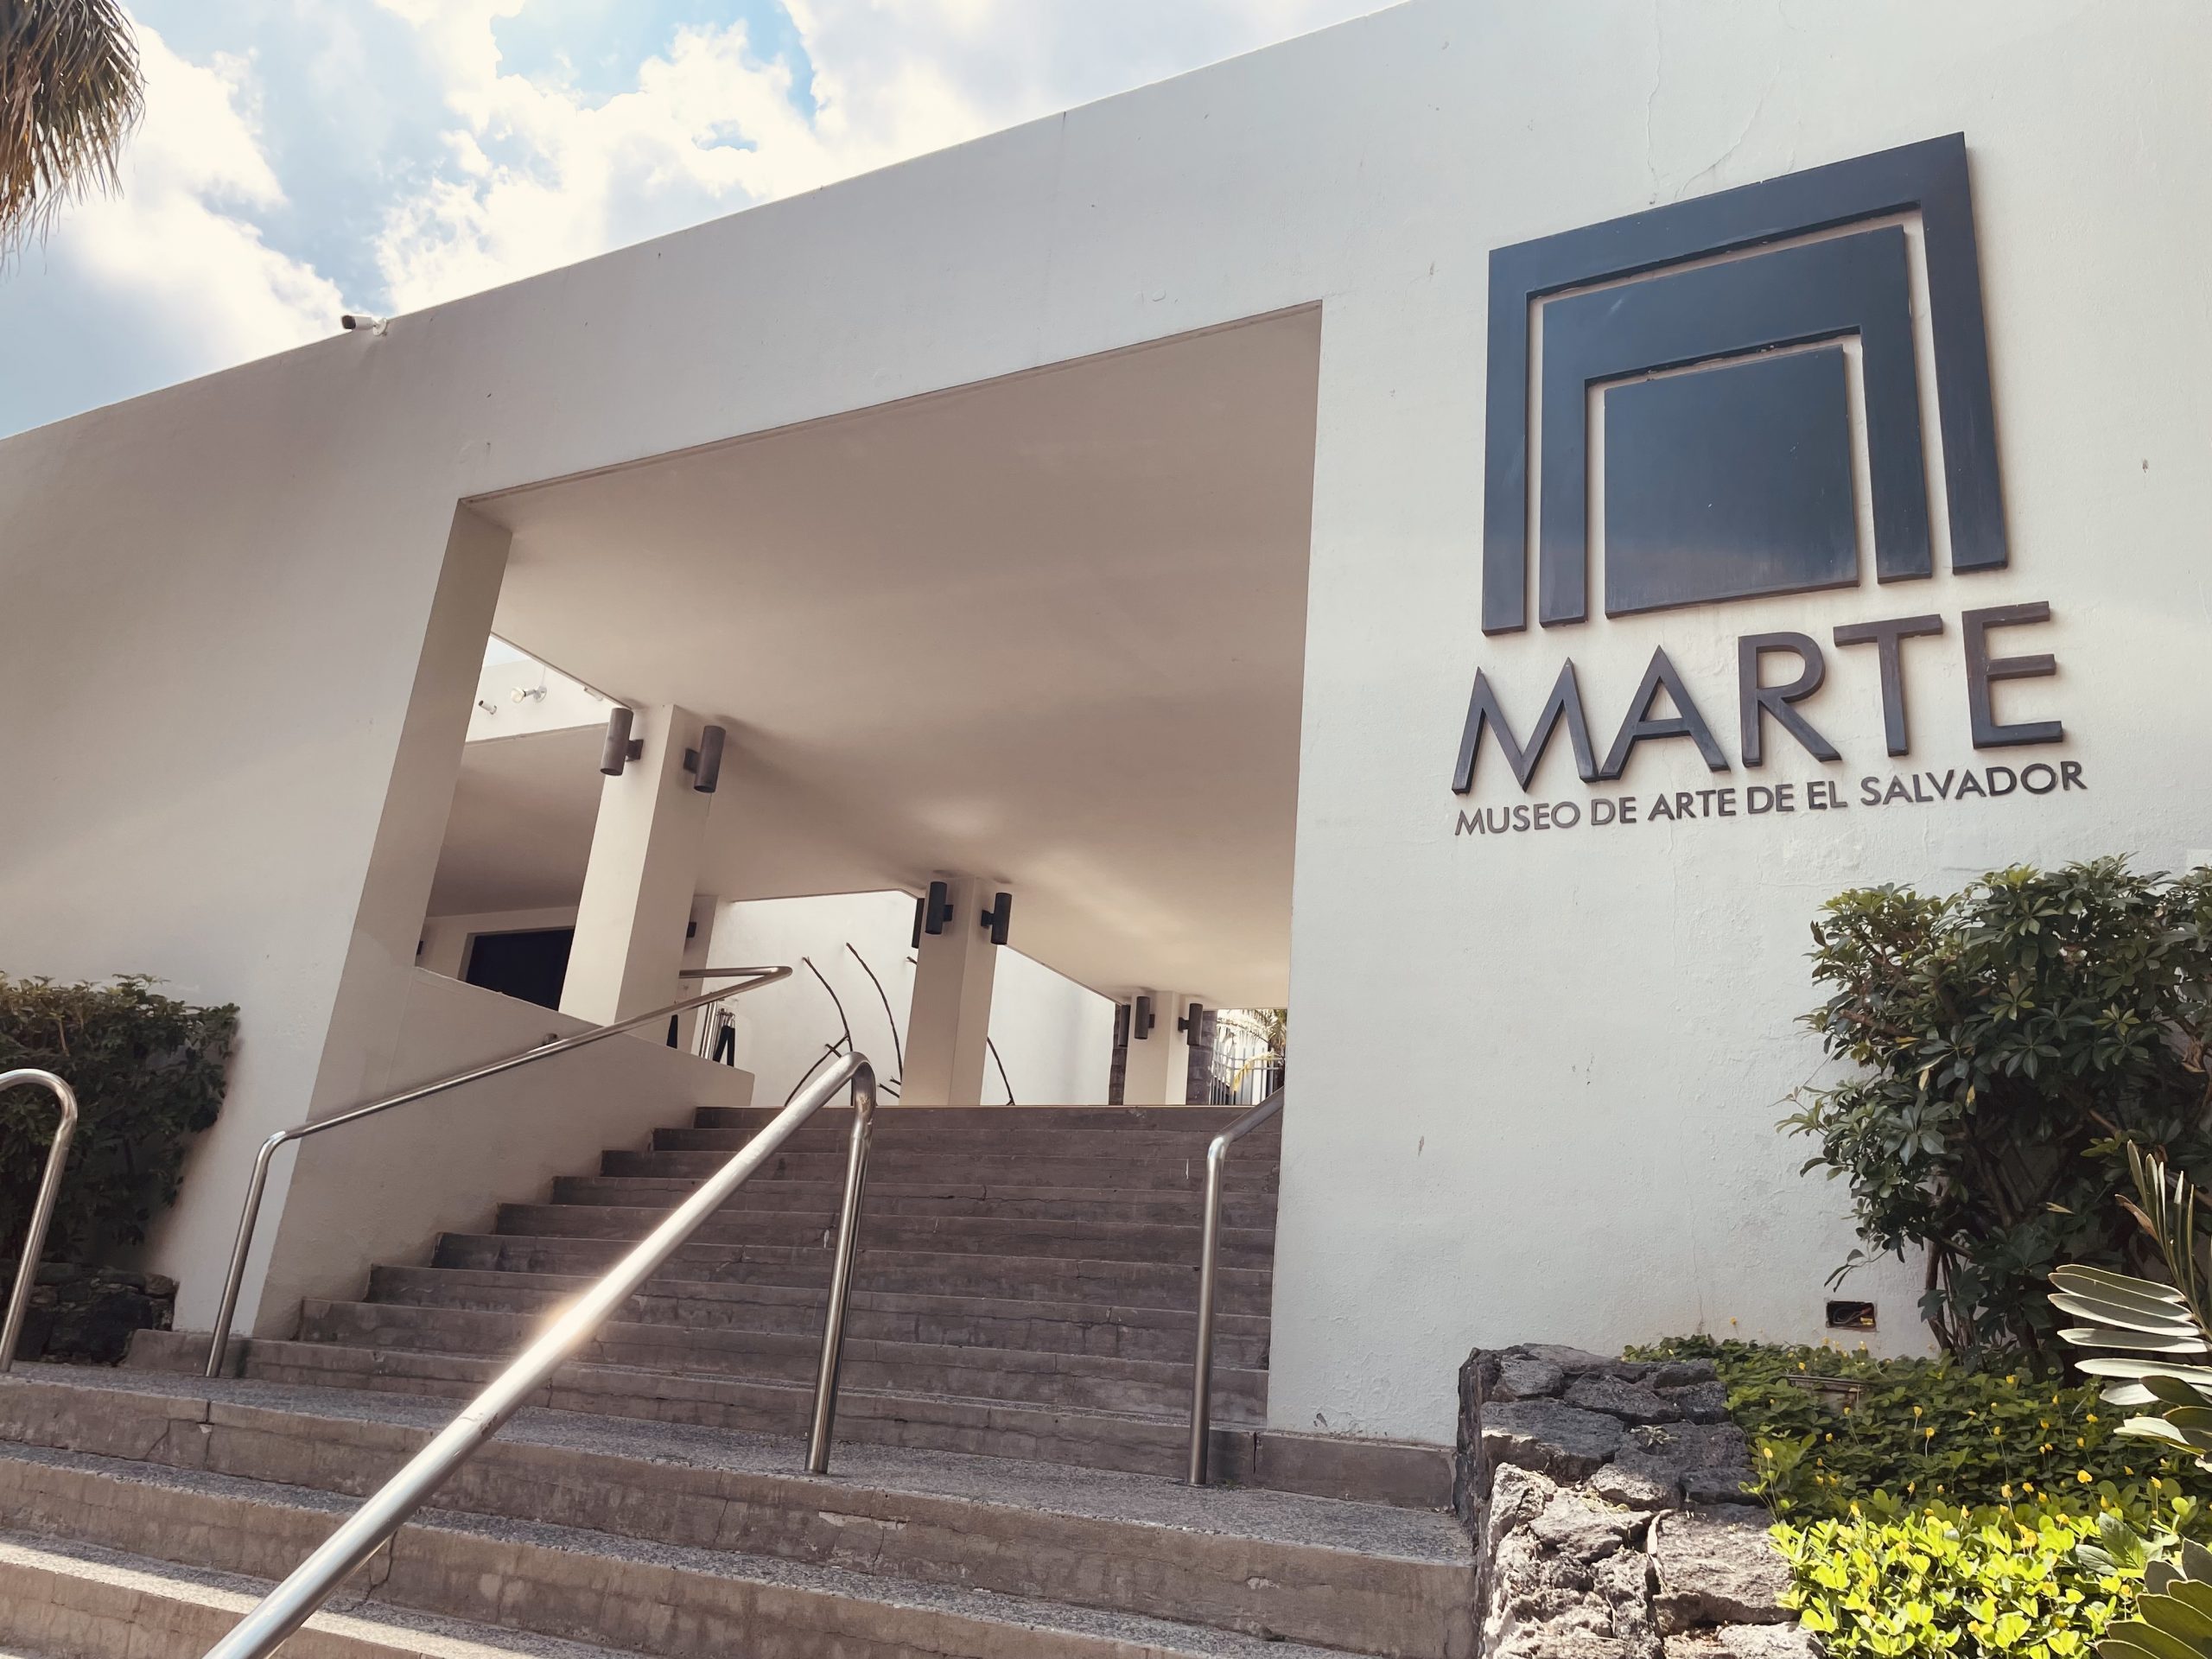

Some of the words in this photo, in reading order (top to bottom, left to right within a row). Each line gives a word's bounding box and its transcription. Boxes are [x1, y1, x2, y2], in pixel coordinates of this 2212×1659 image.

[1452, 601, 2064, 794] MARTE
[1455, 800, 1580, 836] MUSEO
[1591, 797, 1637, 825] DE
[1648, 788, 1736, 822] ARTE
[1747, 784, 1794, 814] DE
[1808, 780, 1847, 810] EL
[1859, 760, 2088, 805] SALVADOR
